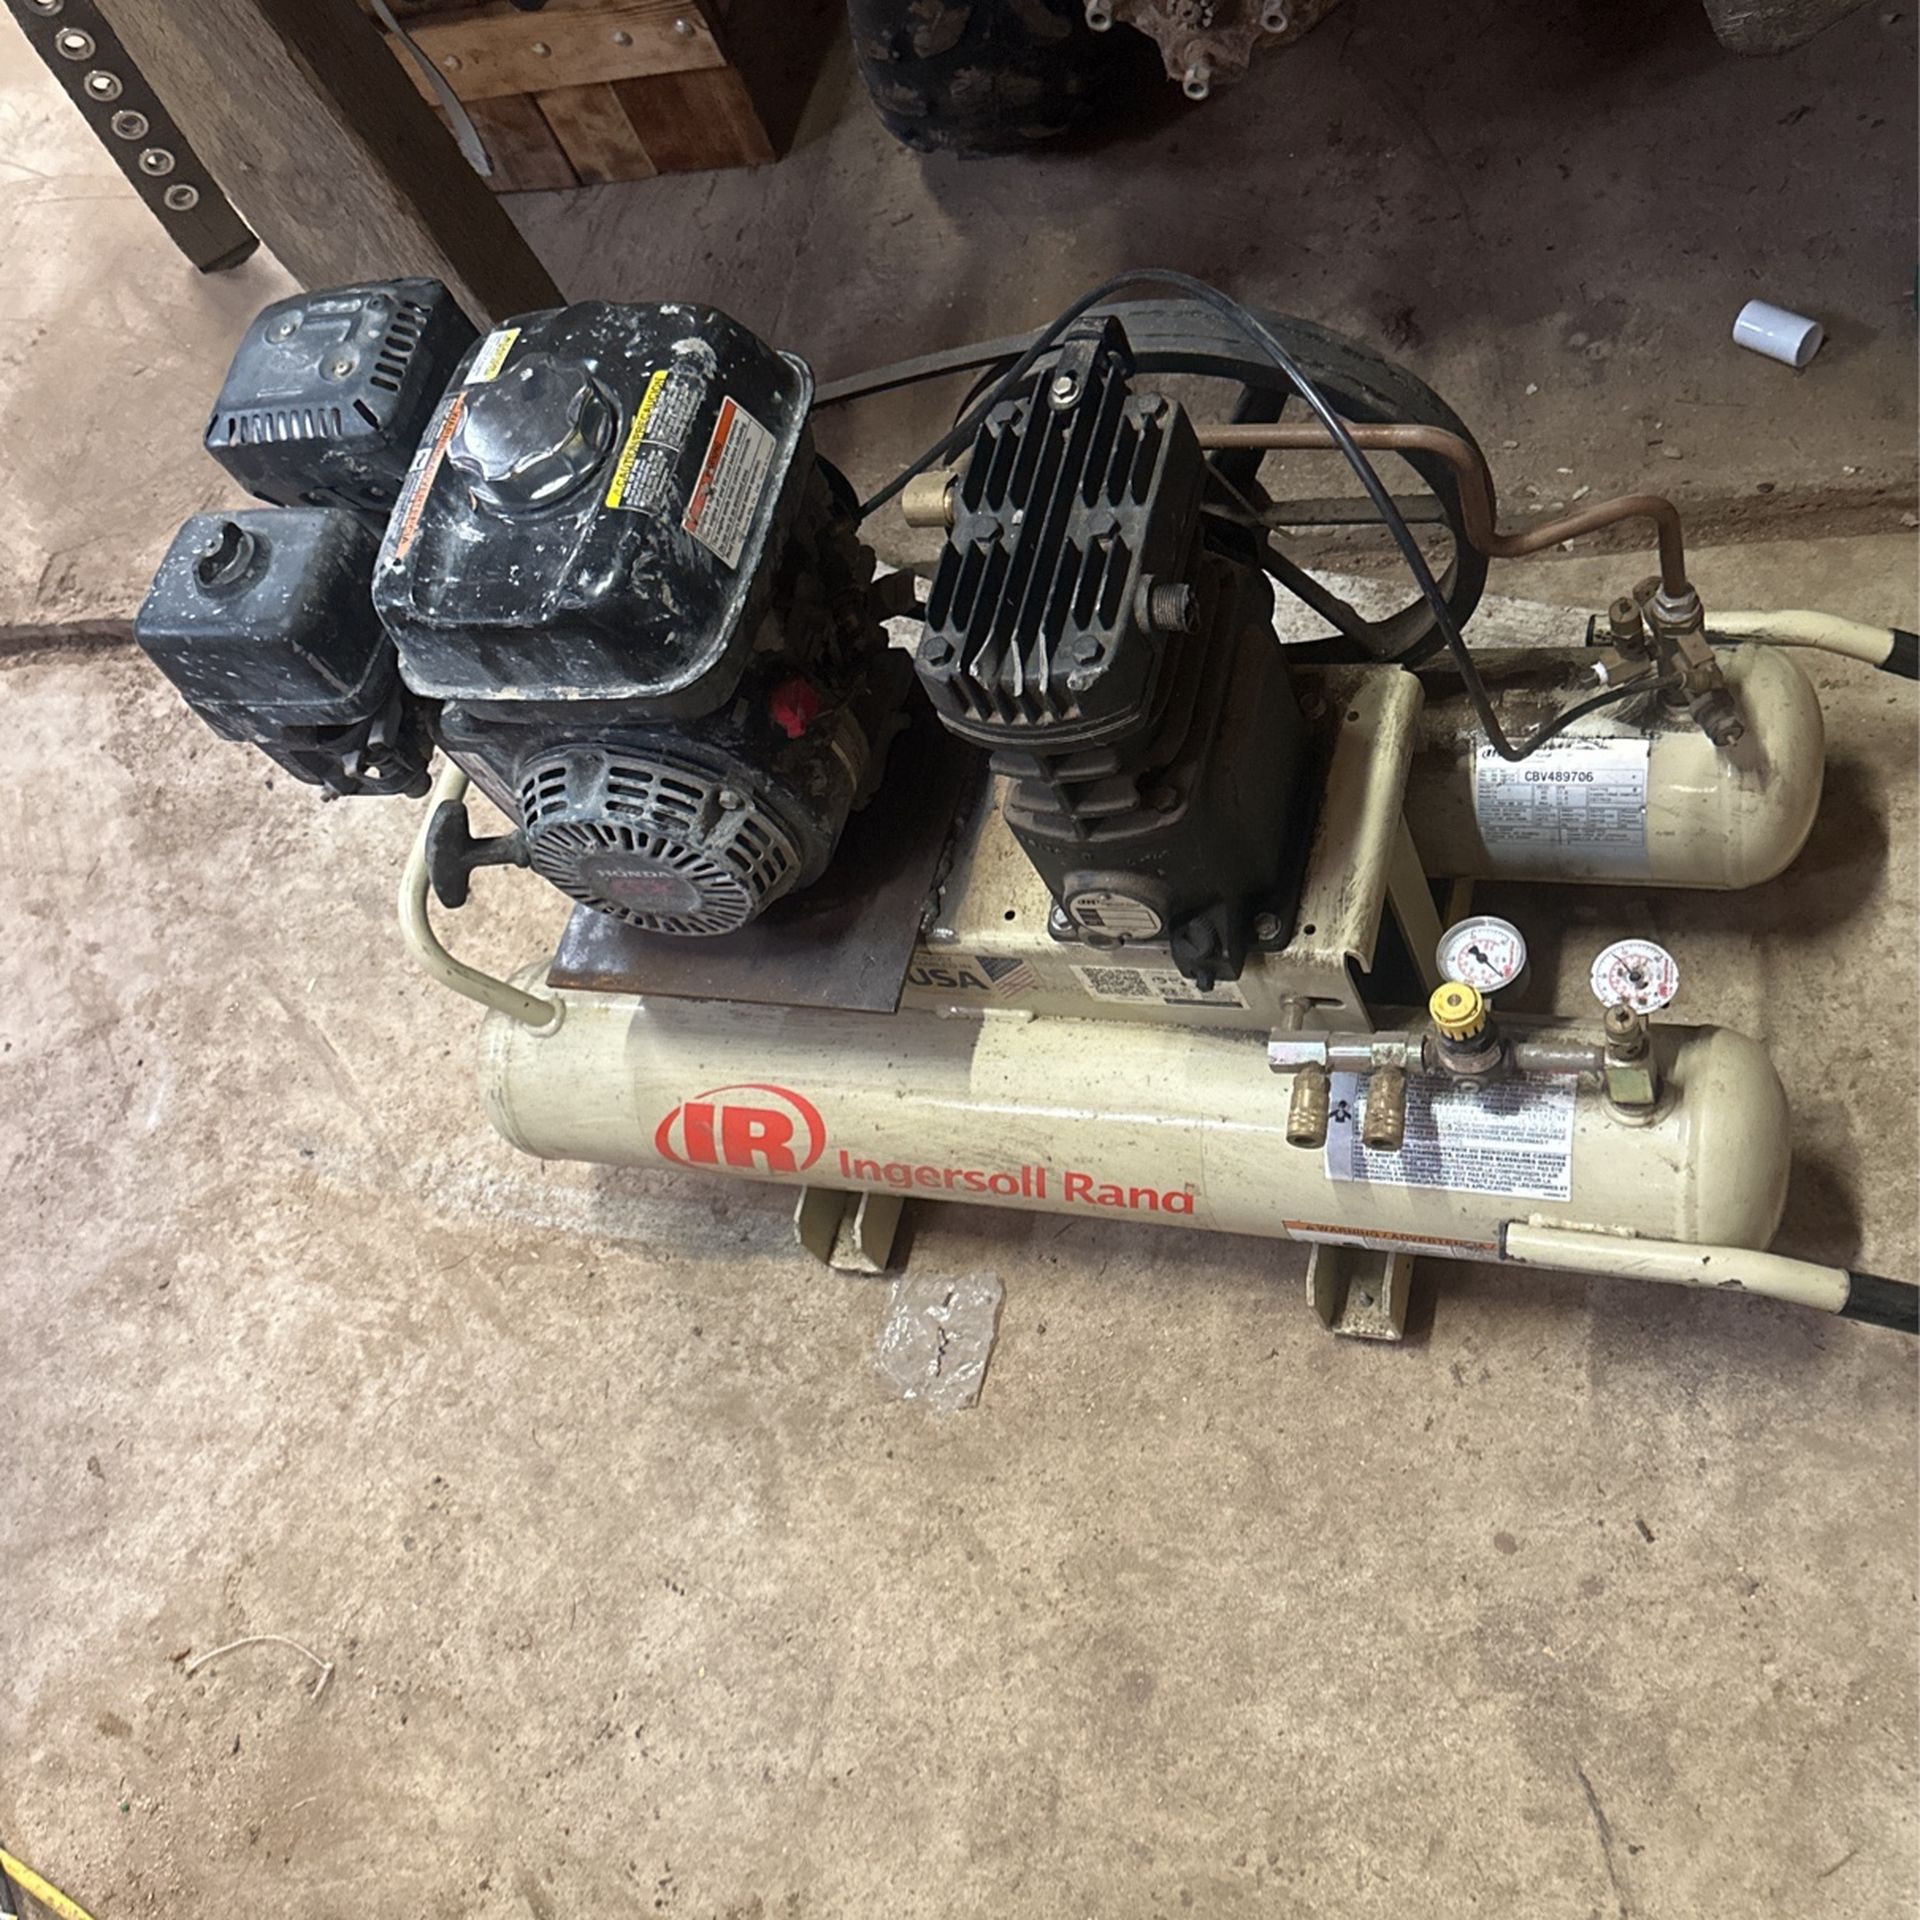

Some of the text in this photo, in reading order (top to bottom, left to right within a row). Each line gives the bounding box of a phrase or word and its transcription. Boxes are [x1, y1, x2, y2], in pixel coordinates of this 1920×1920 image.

[1524, 771, 1594, 782] CBV489706
[909, 967, 990, 990] USA
[683, 1101, 799, 1173] IR
[839, 1150, 1196, 1215] Ingersoll Rand
